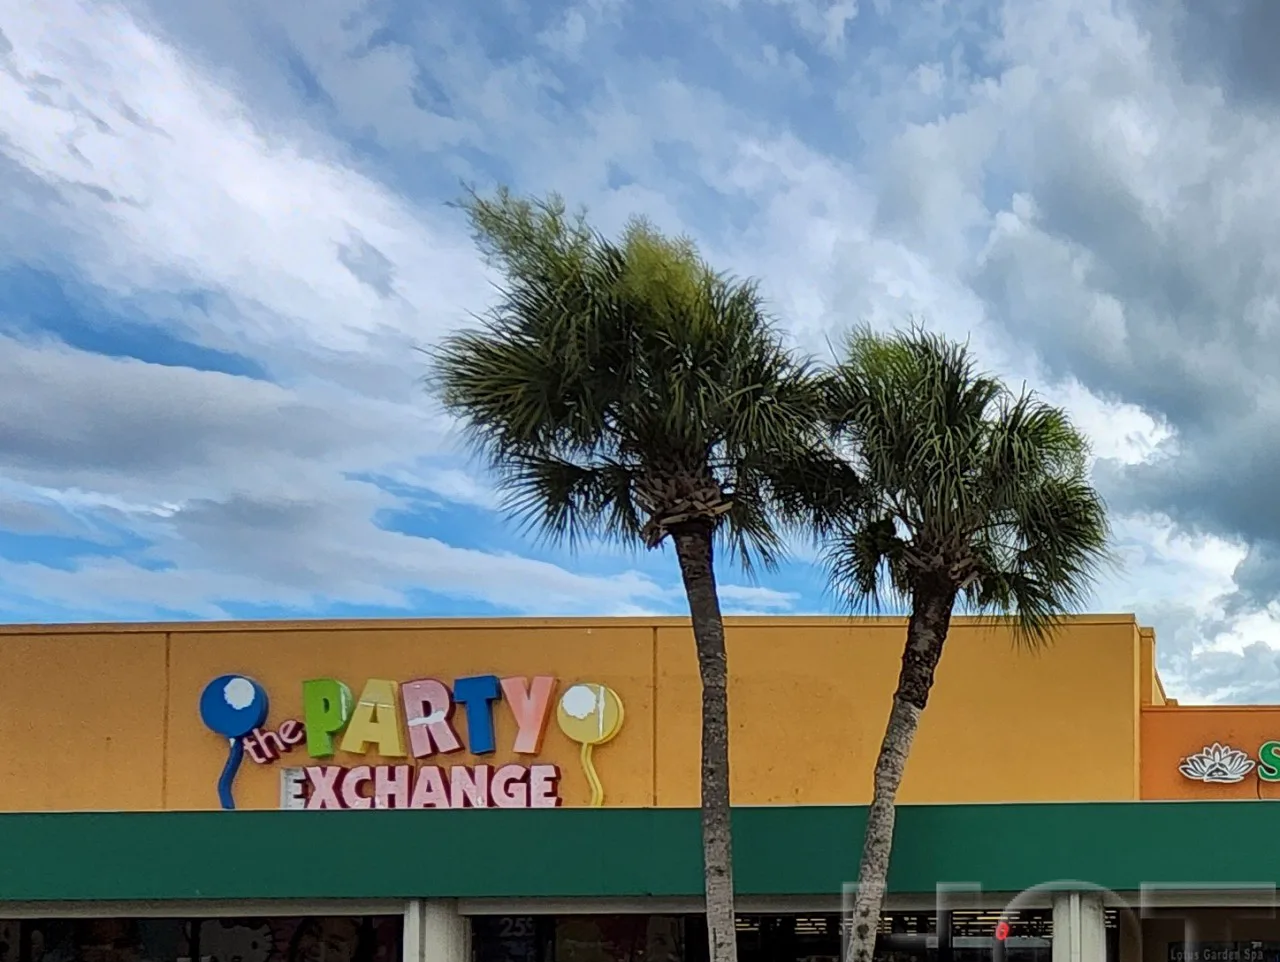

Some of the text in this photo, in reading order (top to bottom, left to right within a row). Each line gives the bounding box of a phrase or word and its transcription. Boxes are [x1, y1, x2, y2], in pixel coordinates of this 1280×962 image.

[244, 675, 559, 764] the PARTY
[281, 764, 561, 808] EXCHANGE
[1170, 949, 1199, 960] Lotus
[1203, 949, 1240, 960] Garden
[1244, 949, 1264, 962] Spa
